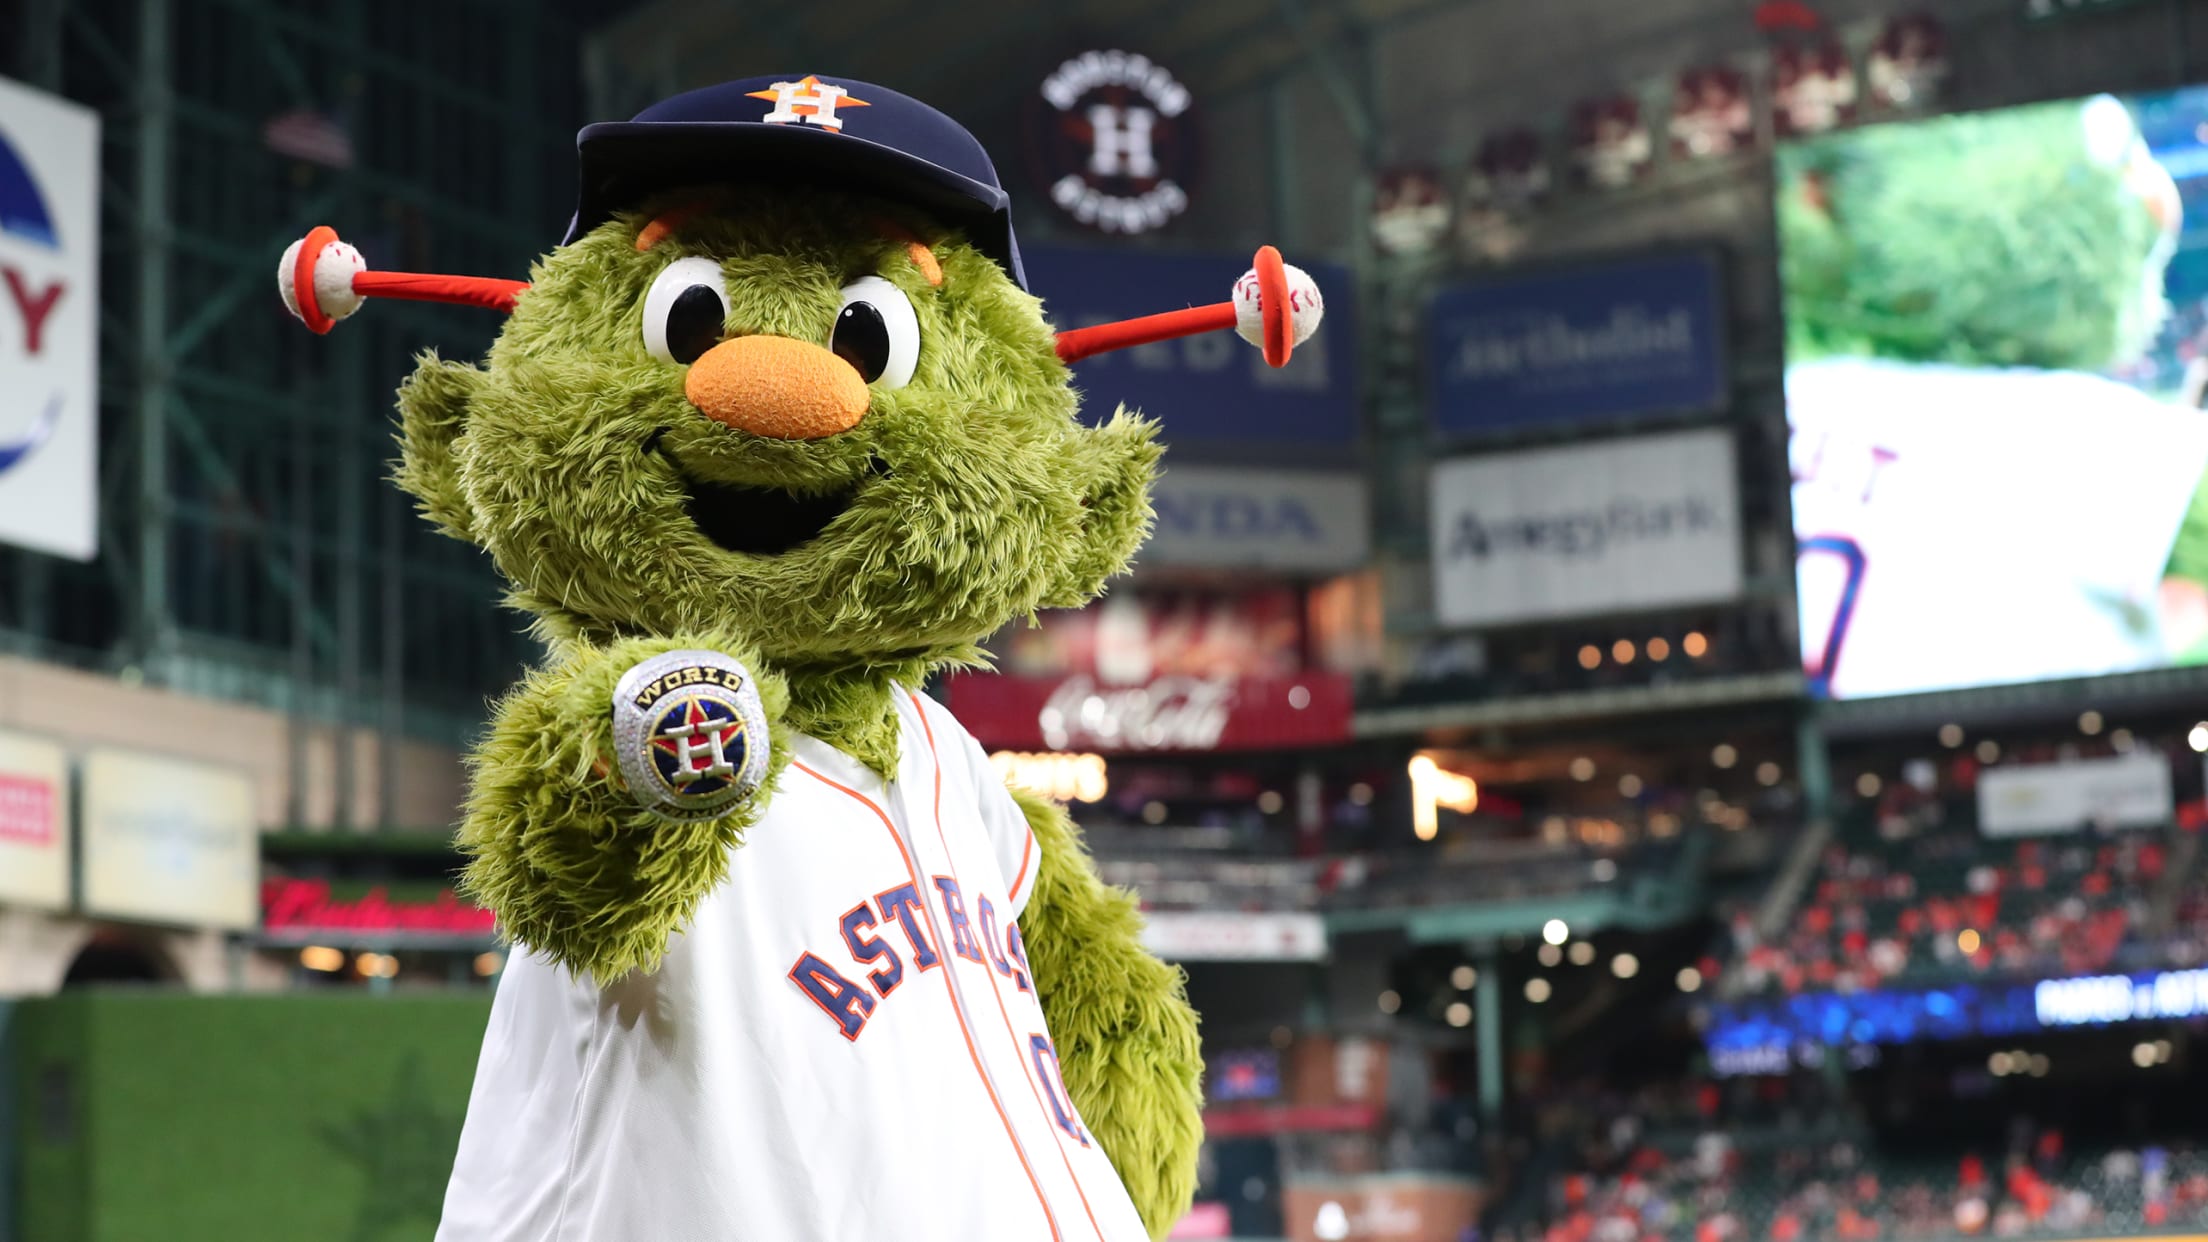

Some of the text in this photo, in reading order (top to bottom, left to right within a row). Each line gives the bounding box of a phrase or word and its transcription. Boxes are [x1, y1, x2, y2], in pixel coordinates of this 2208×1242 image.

[763, 81, 848, 130] H
[1088, 103, 1157, 178] H
[0, 262, 66, 355] Y
[1152, 490, 1324, 541] NDA
[637, 666, 744, 707] WORLD
[664, 717, 734, 785] H
